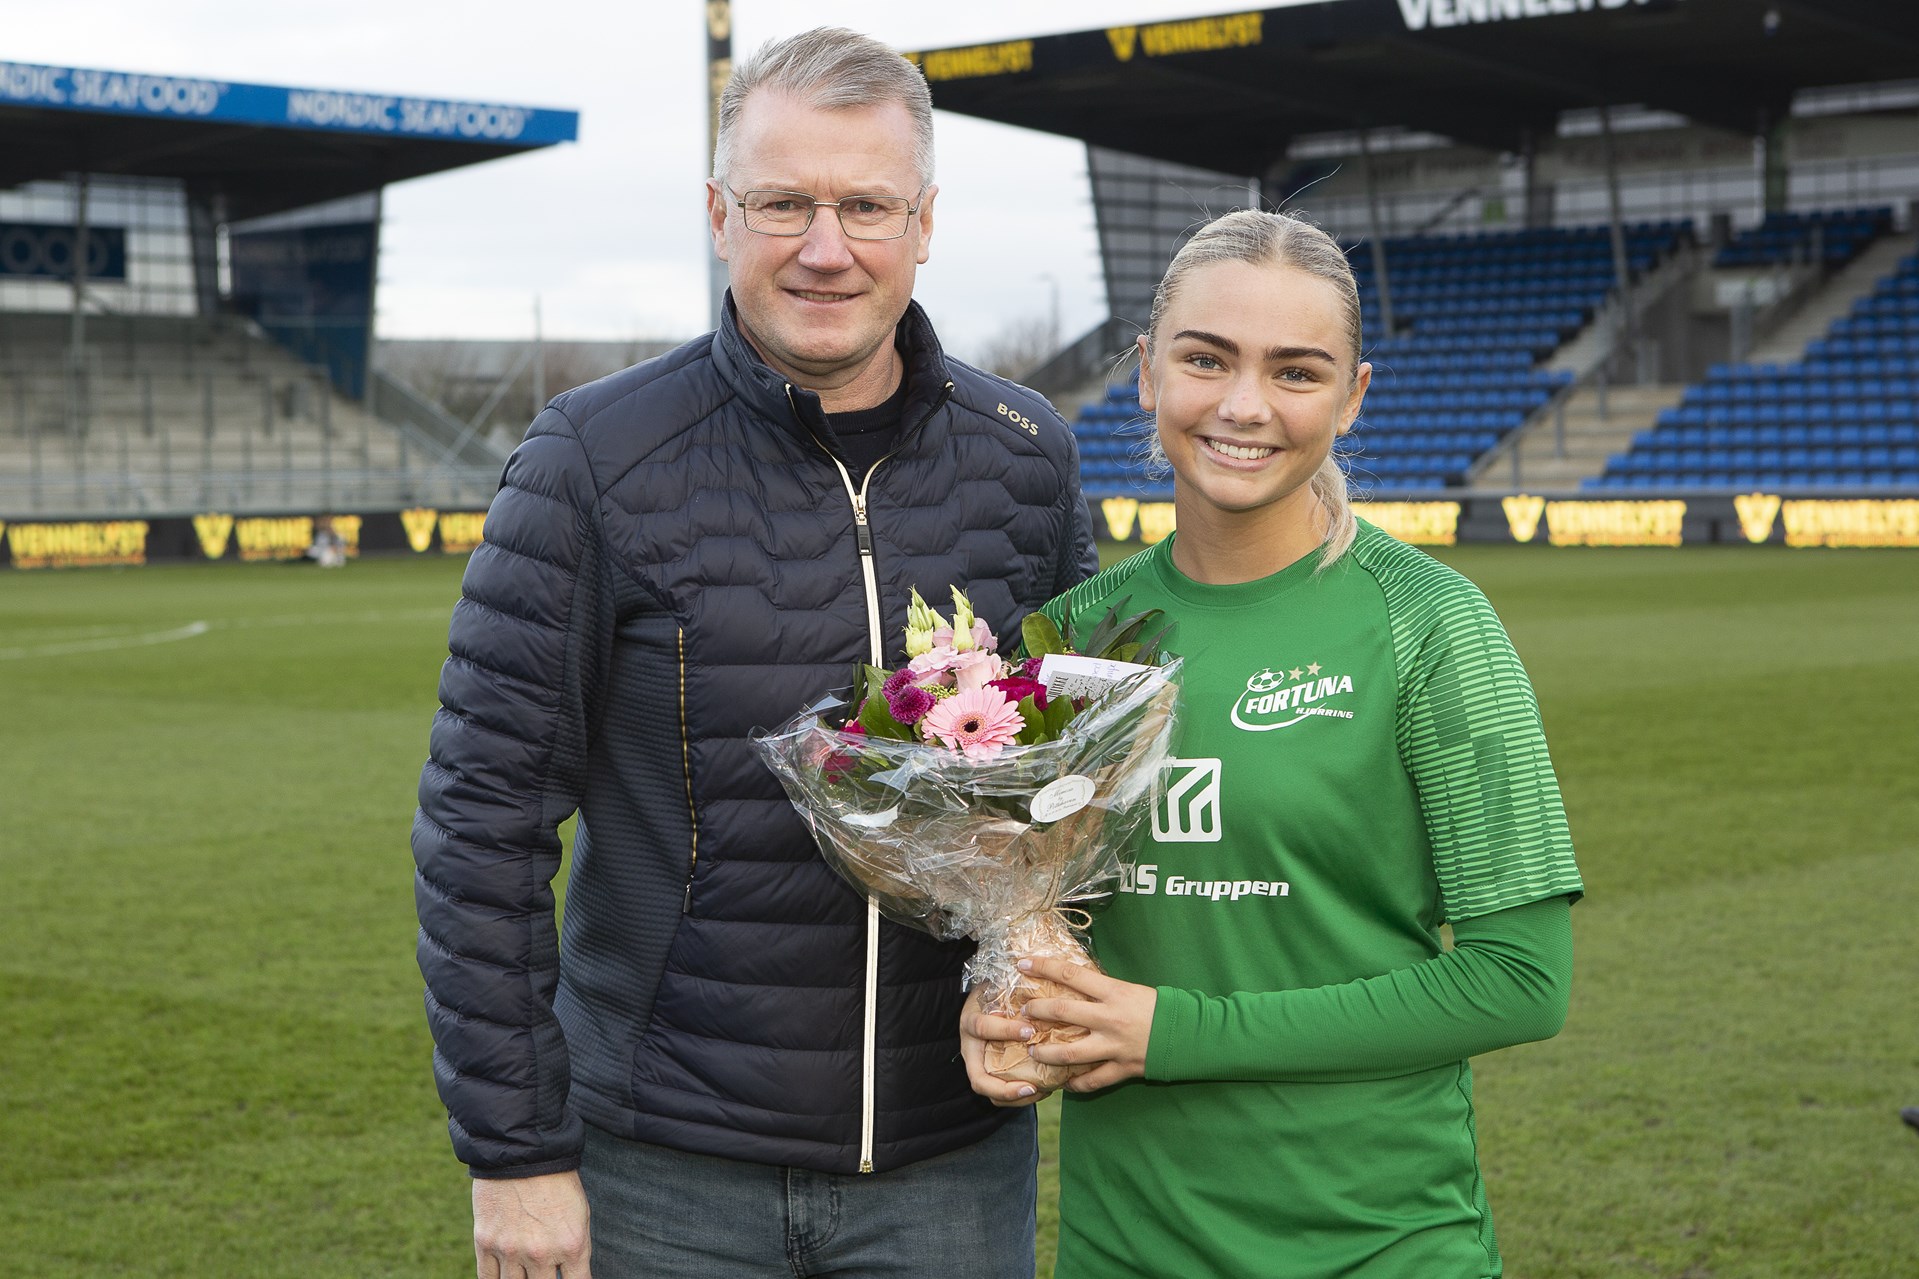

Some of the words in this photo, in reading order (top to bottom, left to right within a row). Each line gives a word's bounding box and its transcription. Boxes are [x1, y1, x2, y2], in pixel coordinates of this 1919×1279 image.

[70, 69, 219, 115] SEAFOOD
[285, 89, 399, 131] NORDIC
[400, 101, 525, 140] SEAFOOD
[997, 402, 1039, 435] BOSS
[1244, 675, 1354, 714] FORTUNA
[1295, 707, 1354, 719] HJØRRING
[1165, 875, 1290, 901] Gruppen
